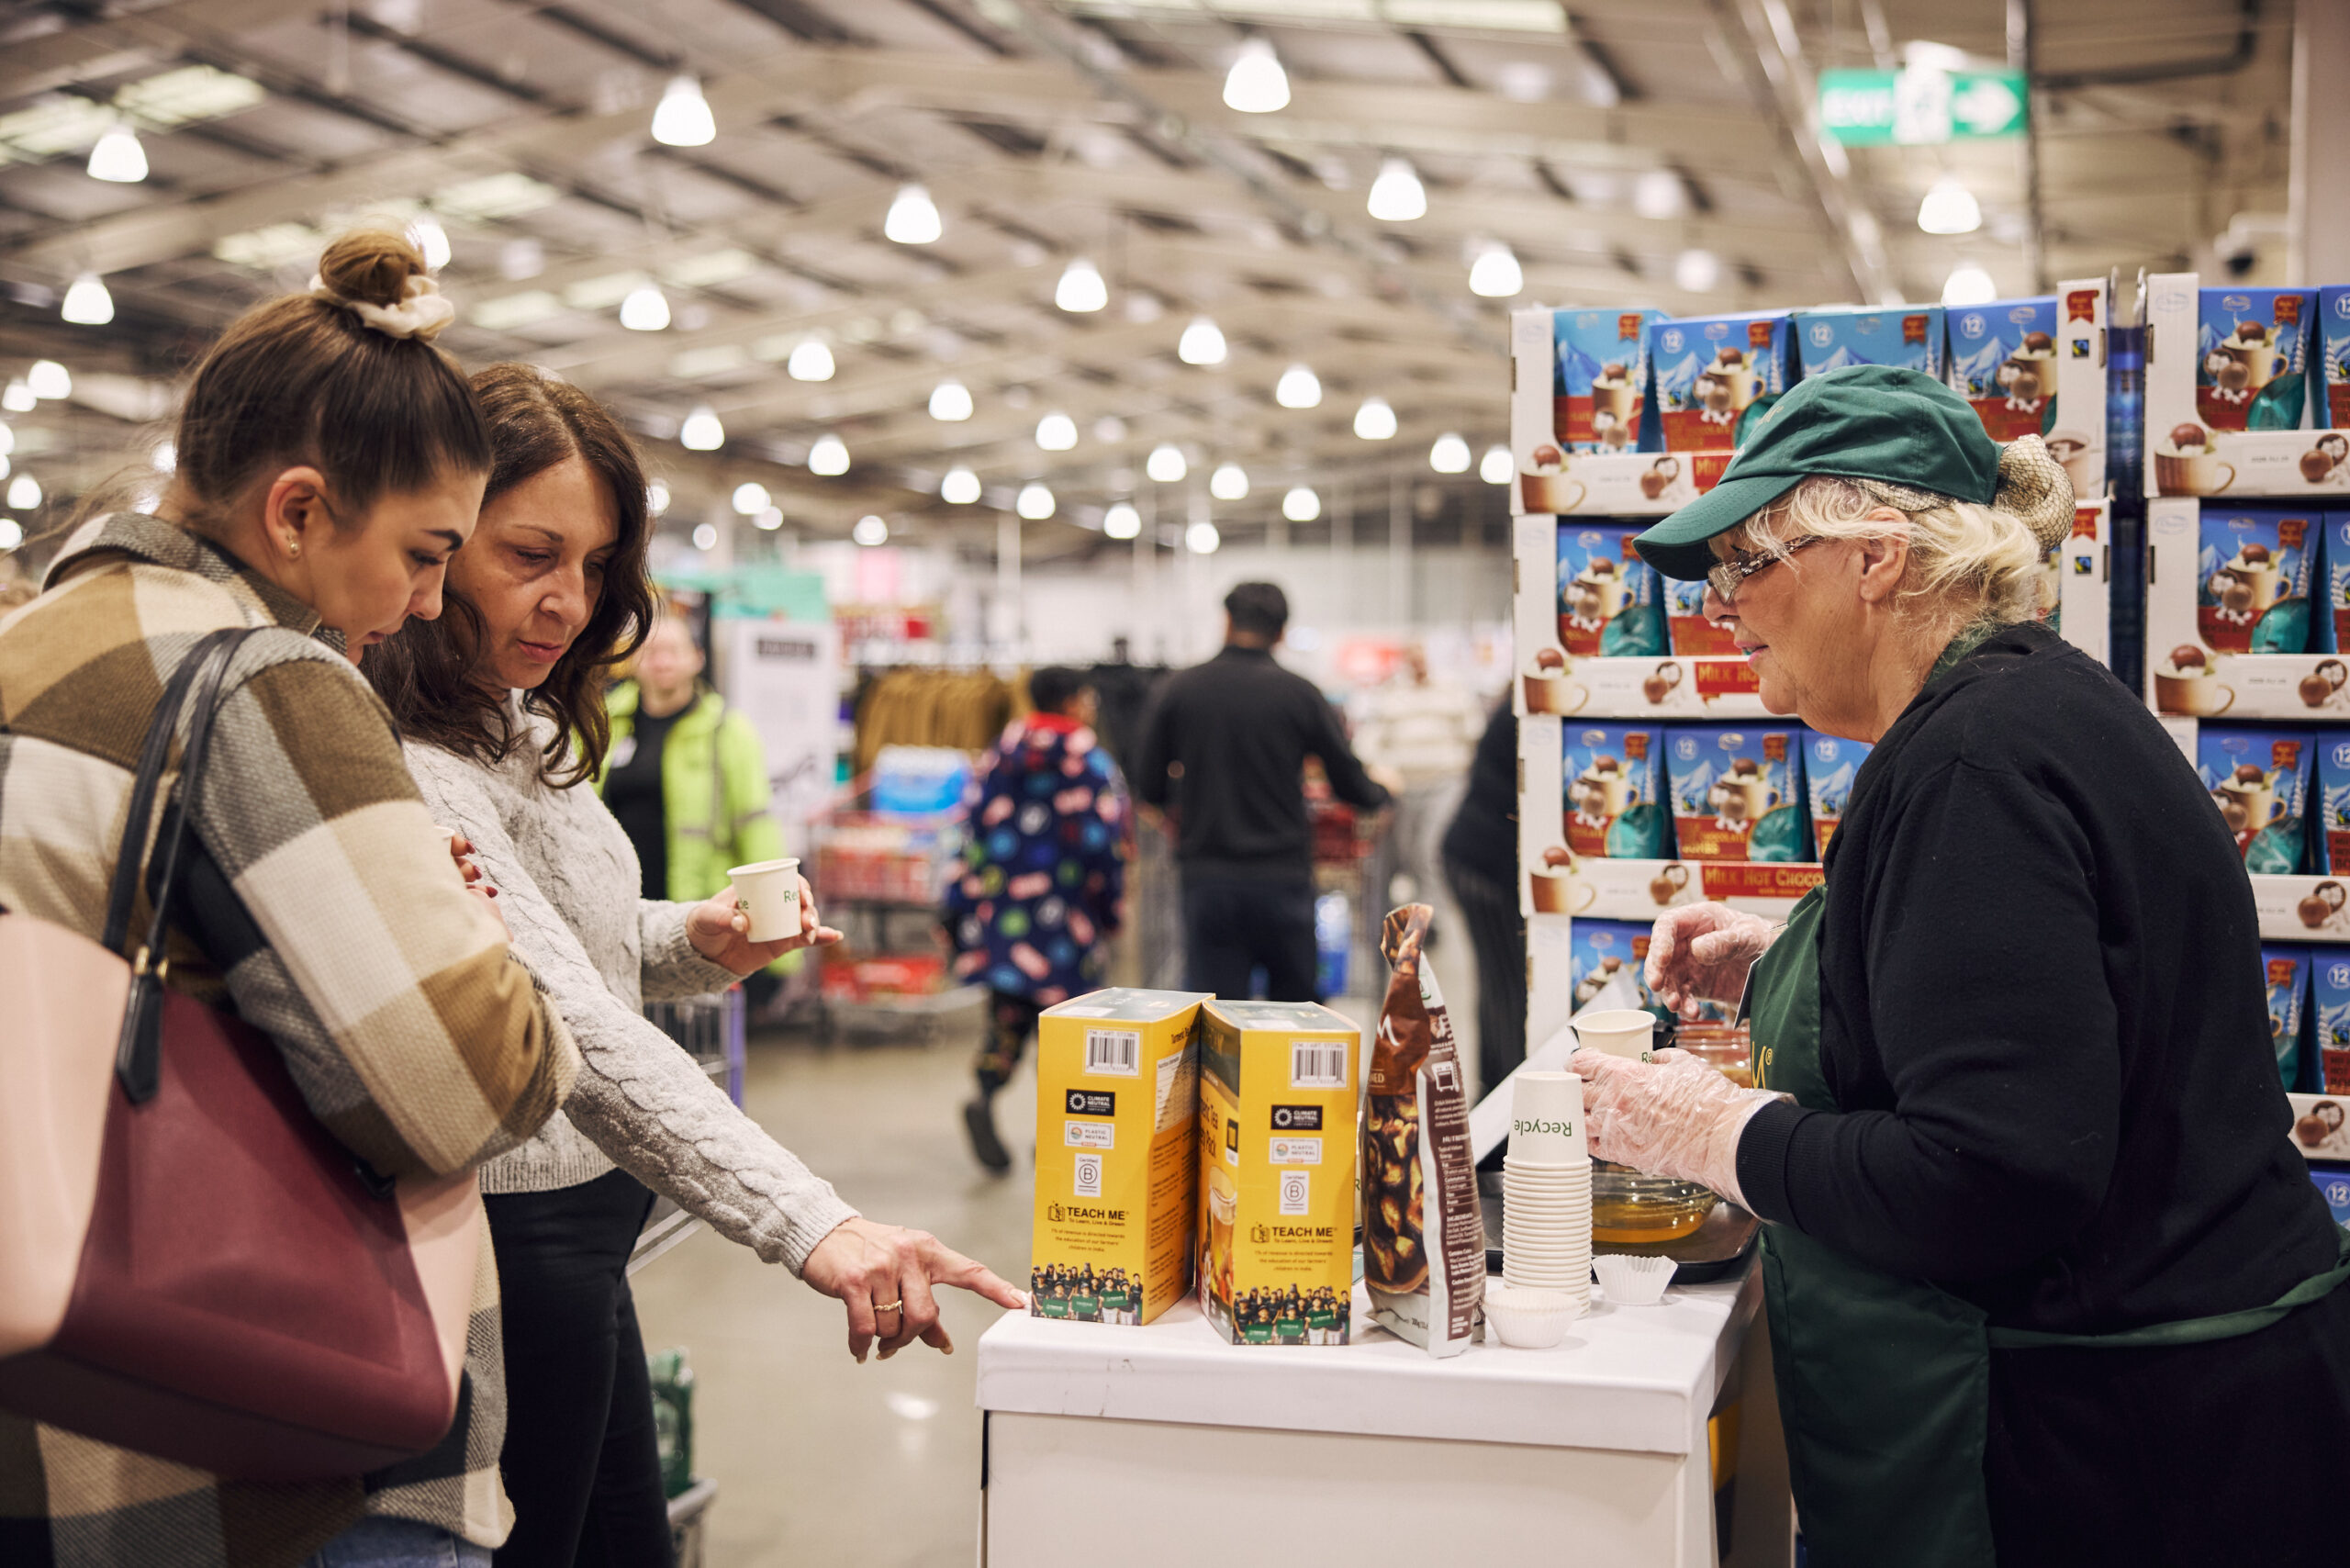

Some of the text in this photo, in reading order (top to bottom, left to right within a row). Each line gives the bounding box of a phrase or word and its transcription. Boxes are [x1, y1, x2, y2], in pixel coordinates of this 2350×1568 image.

[1514, 1118, 1572, 1137] Recycle
[1067, 1206, 1105, 1219] TEACH
[1271, 1226, 1313, 1237] TEACH
